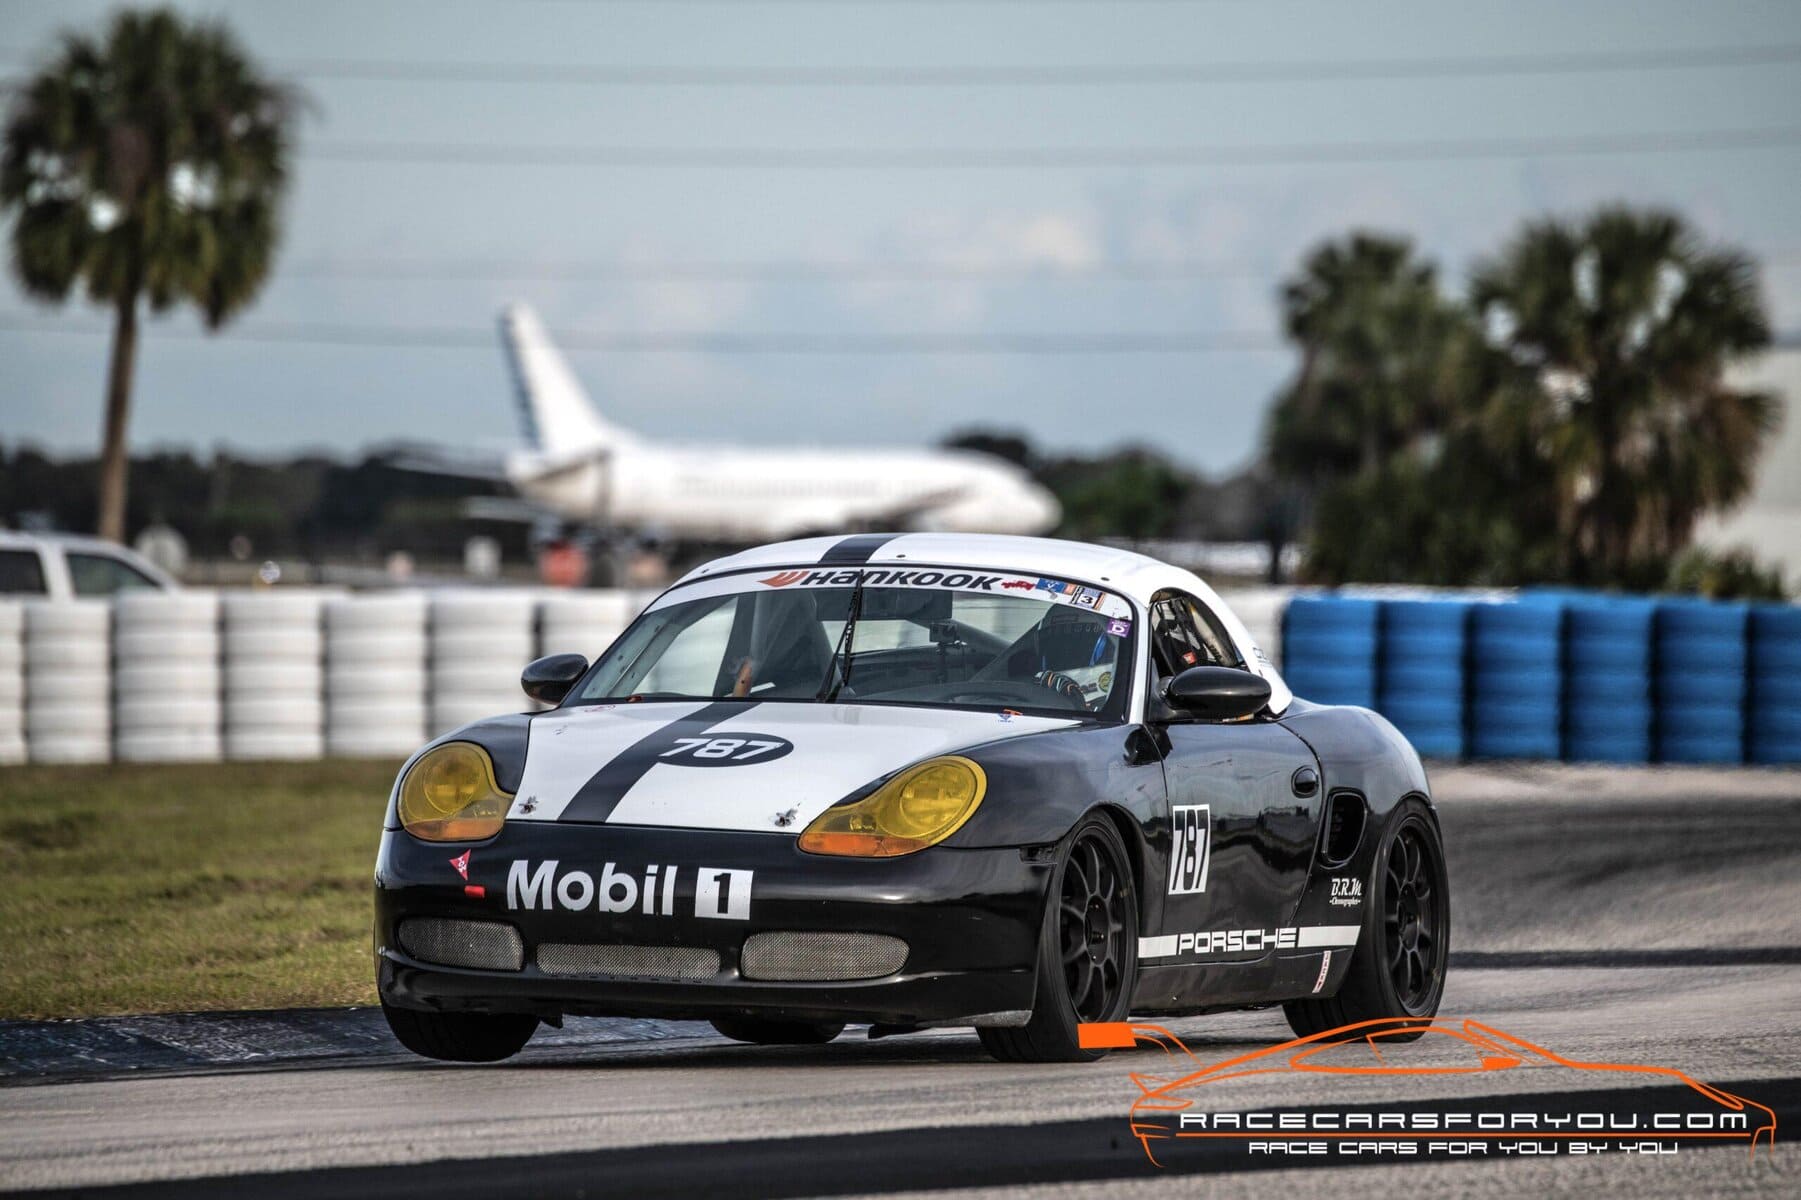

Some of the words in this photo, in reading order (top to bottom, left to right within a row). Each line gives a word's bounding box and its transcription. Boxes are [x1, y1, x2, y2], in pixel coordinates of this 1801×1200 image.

[658, 738, 785, 760] 787
[1172, 809, 1209, 890] 787
[506, 859, 678, 916] Mobil
[713, 872, 733, 914] 1
[1178, 927, 1297, 955] PORSCHE
